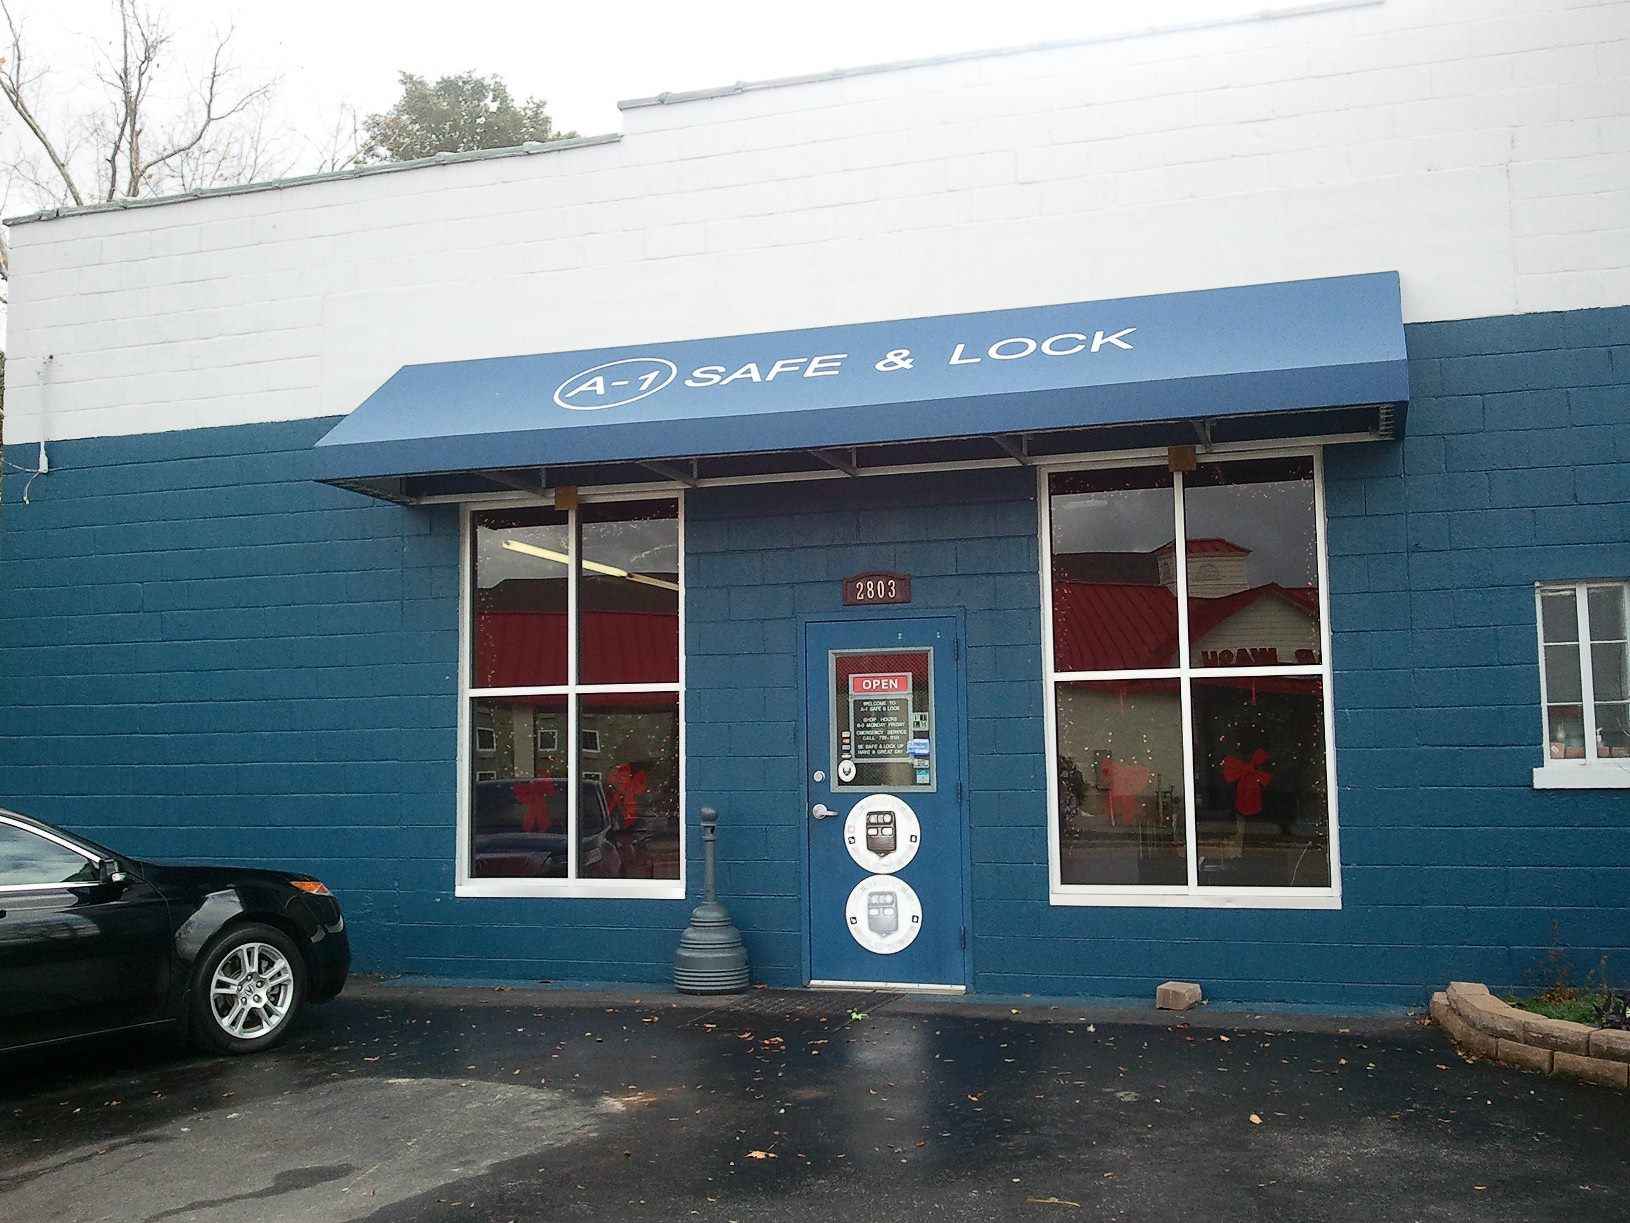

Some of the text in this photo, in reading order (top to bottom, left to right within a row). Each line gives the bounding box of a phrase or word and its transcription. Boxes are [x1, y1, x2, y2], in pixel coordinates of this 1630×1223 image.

[564, 327, 1138, 398] A-1 SAFE & LOCK
[856, 579, 896, 600] 2803
[862, 678, 898, 690] OPEN
